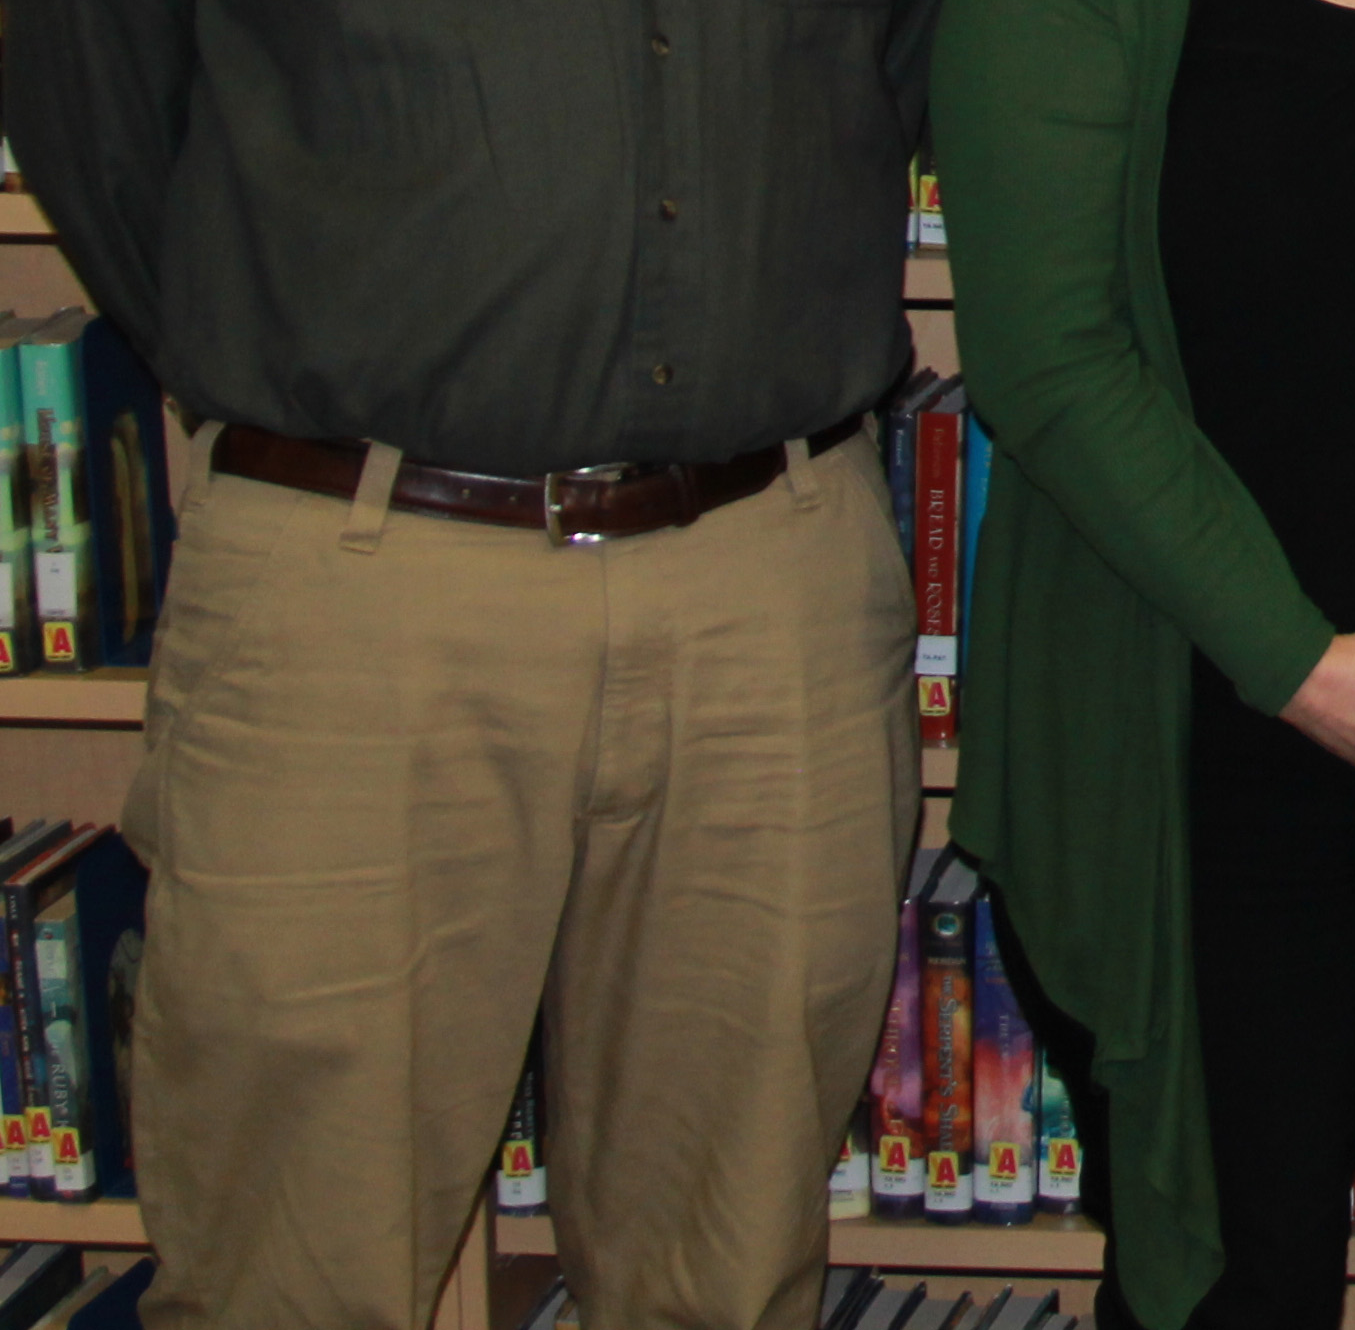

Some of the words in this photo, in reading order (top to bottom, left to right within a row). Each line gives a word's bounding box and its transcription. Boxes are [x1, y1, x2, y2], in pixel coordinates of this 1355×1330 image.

[928, 489, 944, 550] BREAD
[939, 998, 960, 1096] SERPENT'S
[50, 1063, 70, 1108] RUBY
